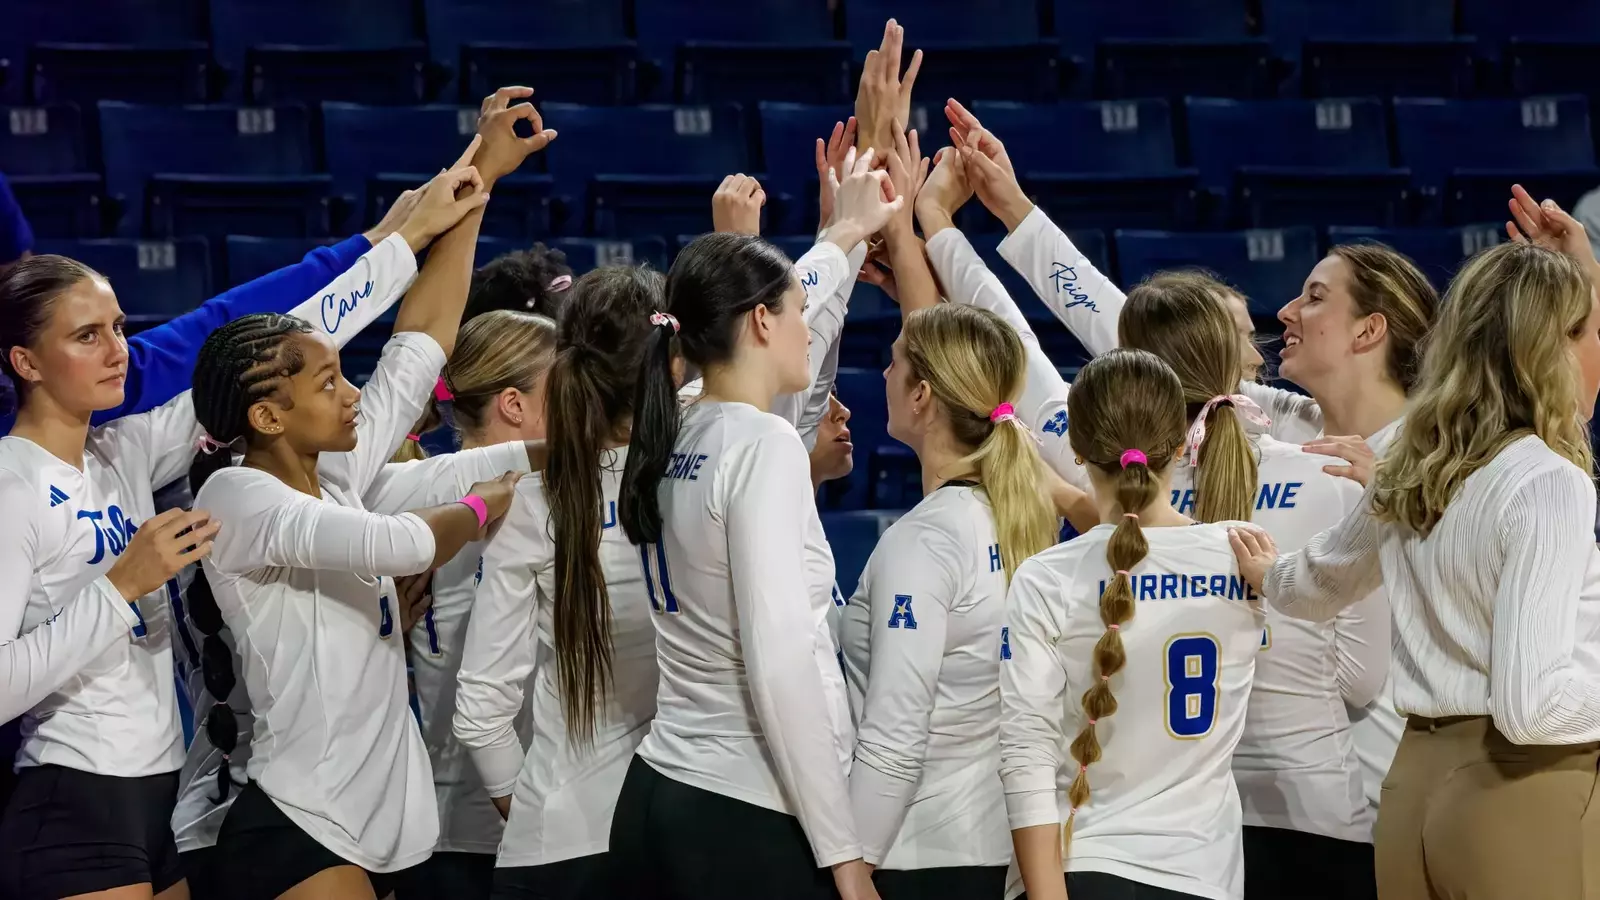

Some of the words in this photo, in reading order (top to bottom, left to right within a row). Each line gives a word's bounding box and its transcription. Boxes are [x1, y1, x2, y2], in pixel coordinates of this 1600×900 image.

[321, 280, 375, 334] Cane
[1048, 261, 1101, 314] Reign
[1163, 631, 1222, 741] 8
